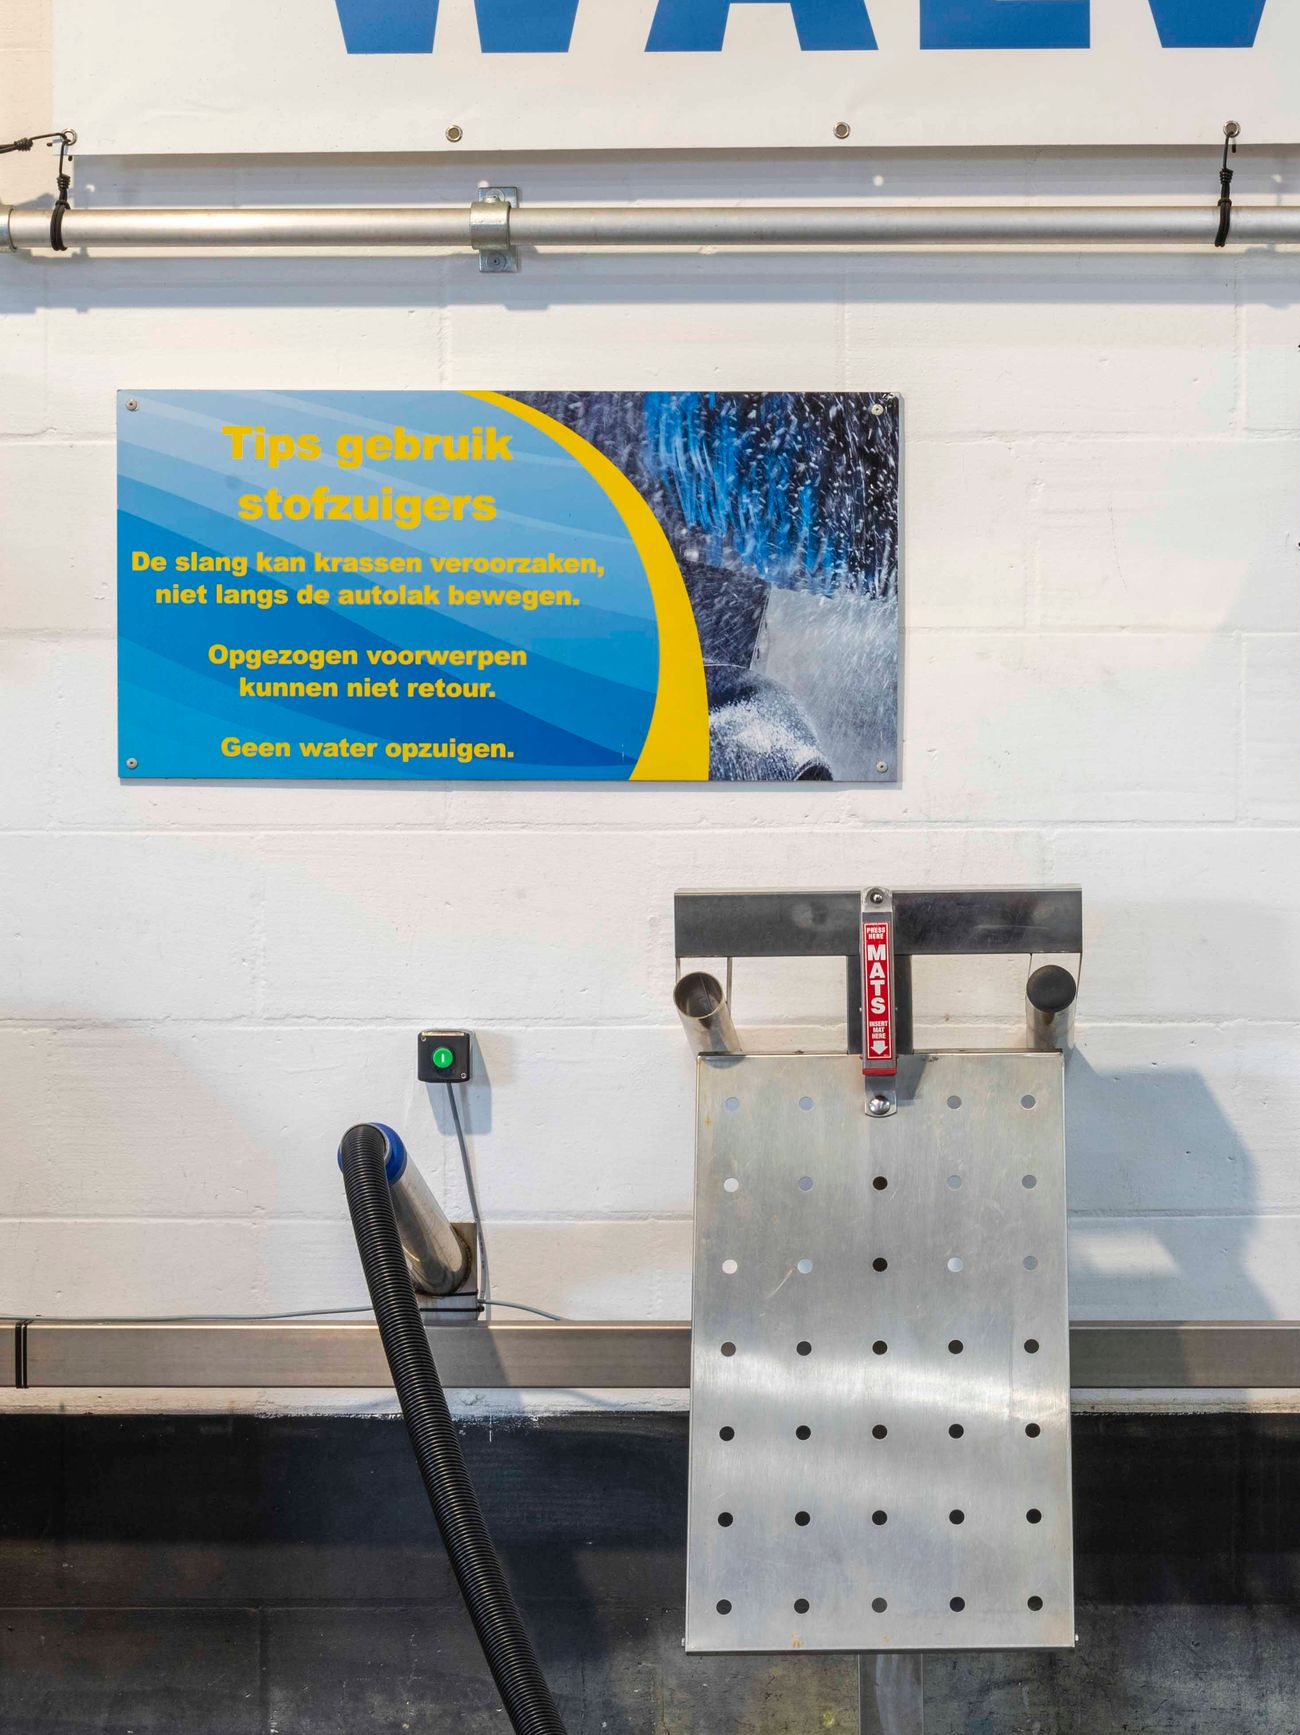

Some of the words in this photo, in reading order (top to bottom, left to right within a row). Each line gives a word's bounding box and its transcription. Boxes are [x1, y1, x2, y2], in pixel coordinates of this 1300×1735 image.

[222, 425, 321, 468] Tips
[336, 425, 513, 469] gebruik
[238, 486, 497, 529] stofzuigers
[132, 551, 167, 572] De
[175, 551, 248, 577] slang
[256, 551, 305, 573] kan
[314, 551, 422, 573] krassen
[430, 553, 605, 577] veroorzaken,
[156, 584, 207, 605] niet
[216, 584, 289, 609] langs
[296, 584, 330, 605] de
[338, 584, 441, 606] autolak
[448, 585, 580, 610] bewegen.
[208, 644, 358, 670] Opgezogen
[366, 649, 527, 670] voorwerpen
[239, 677, 338, 698] kunnen
[346, 677, 399, 698] niet
[407, 678, 496, 698] retour.
[220, 737, 291, 758] Geen
[300, 739, 378, 758] water
[385, 738, 515, 762] opzuigen.
[867, 943, 886, 1014] MATS
